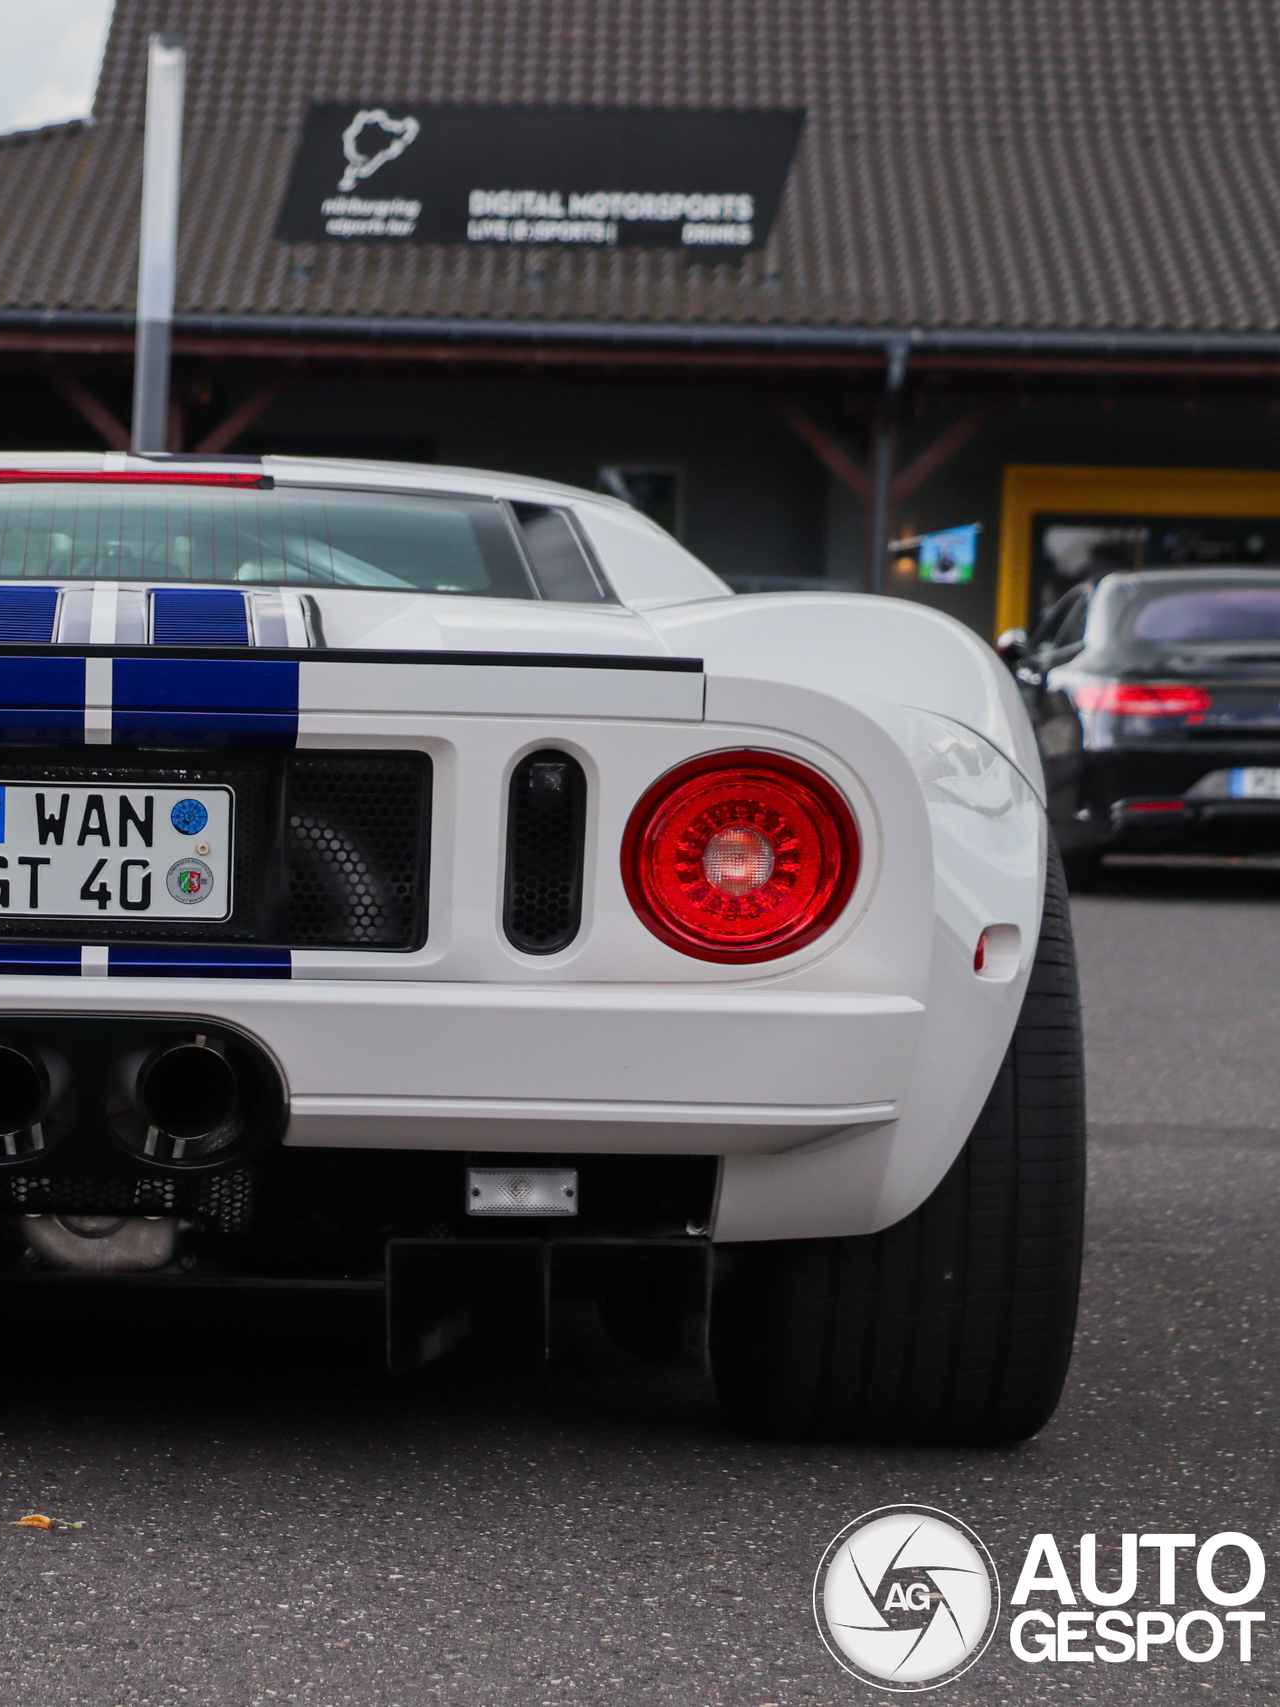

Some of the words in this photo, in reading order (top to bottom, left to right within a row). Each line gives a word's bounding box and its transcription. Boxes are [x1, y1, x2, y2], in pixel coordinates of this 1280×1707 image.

[469, 189, 564, 219] DIGITAL
[568, 191, 754, 221] MOTORSPORTS
[35, 792, 154, 847] WAN
[80, 858, 152, 911] 40
